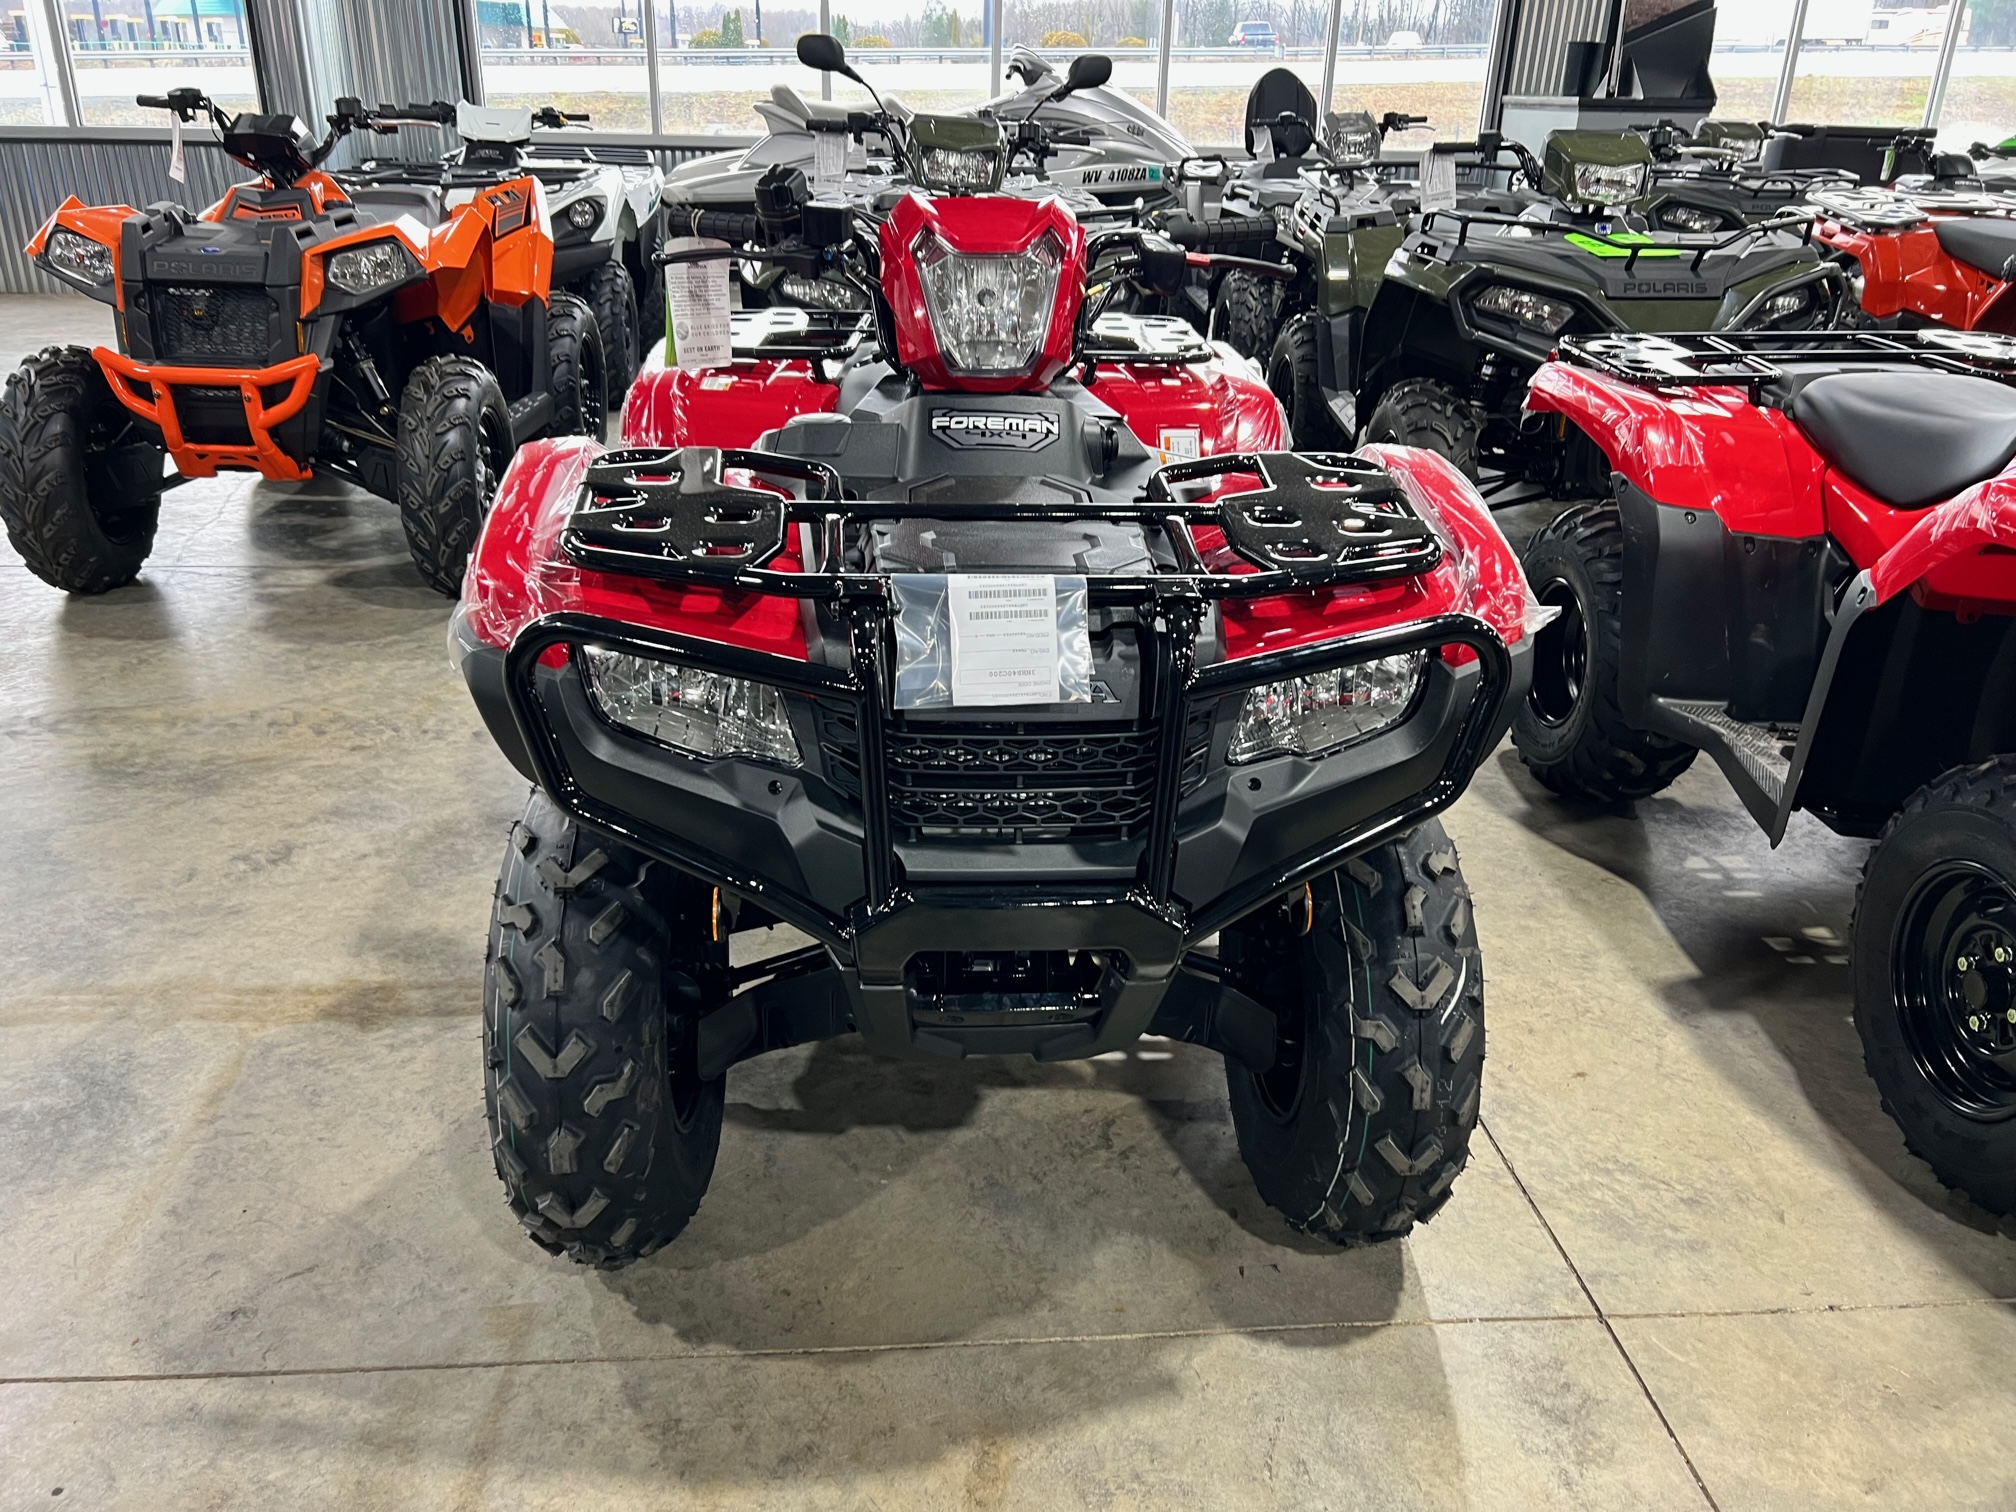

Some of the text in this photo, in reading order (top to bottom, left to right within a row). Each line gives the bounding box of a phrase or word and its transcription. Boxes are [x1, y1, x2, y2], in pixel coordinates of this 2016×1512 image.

[1082, 167, 1147, 184] WV 4108ZA
[153, 260, 257, 276] POLARIS
[1623, 282, 1708, 294] POLARIS
[932, 416, 1059, 435] FOREMAN
